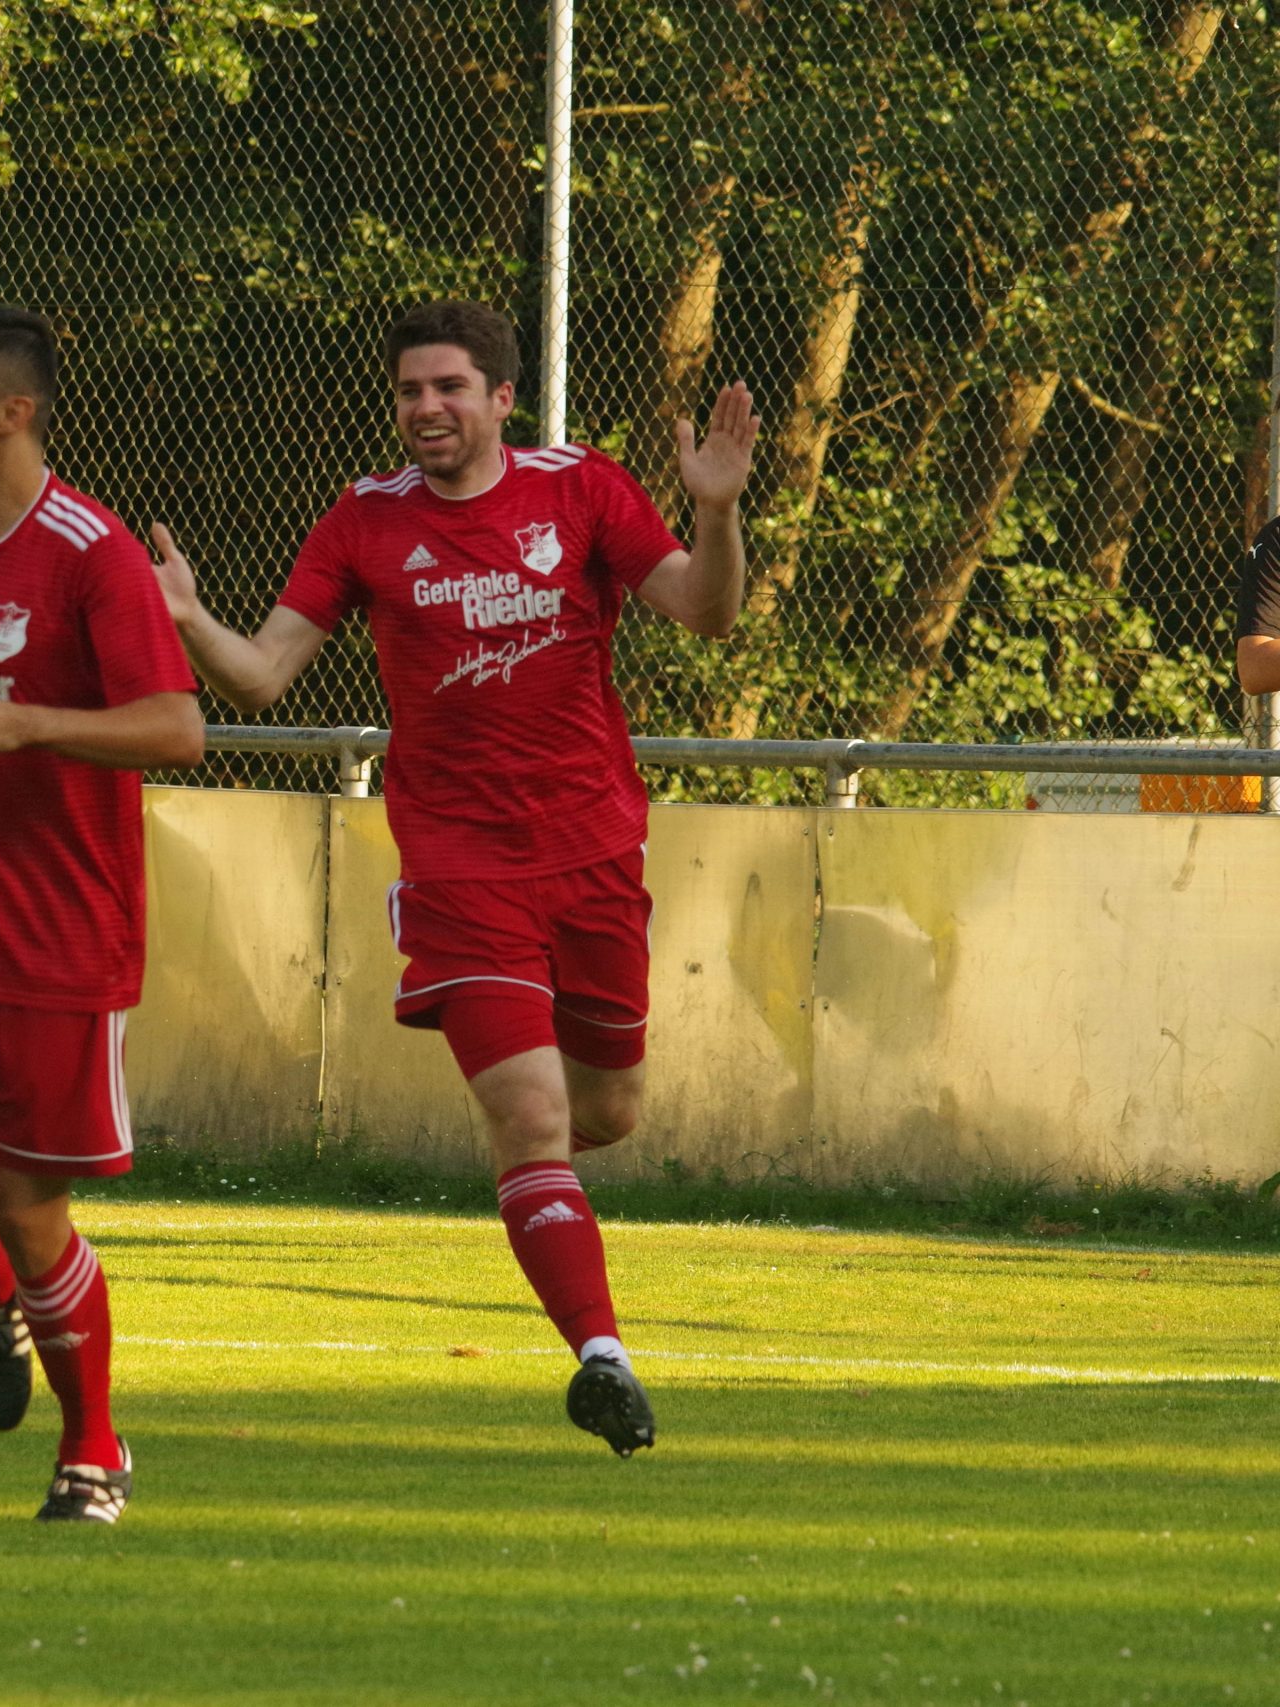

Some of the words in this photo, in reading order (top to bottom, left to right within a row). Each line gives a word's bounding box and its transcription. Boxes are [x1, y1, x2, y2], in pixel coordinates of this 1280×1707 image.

[402, 557, 439, 572] adidas
[413, 569, 520, 607] Getränke
[462, 585, 565, 630] Rieder
